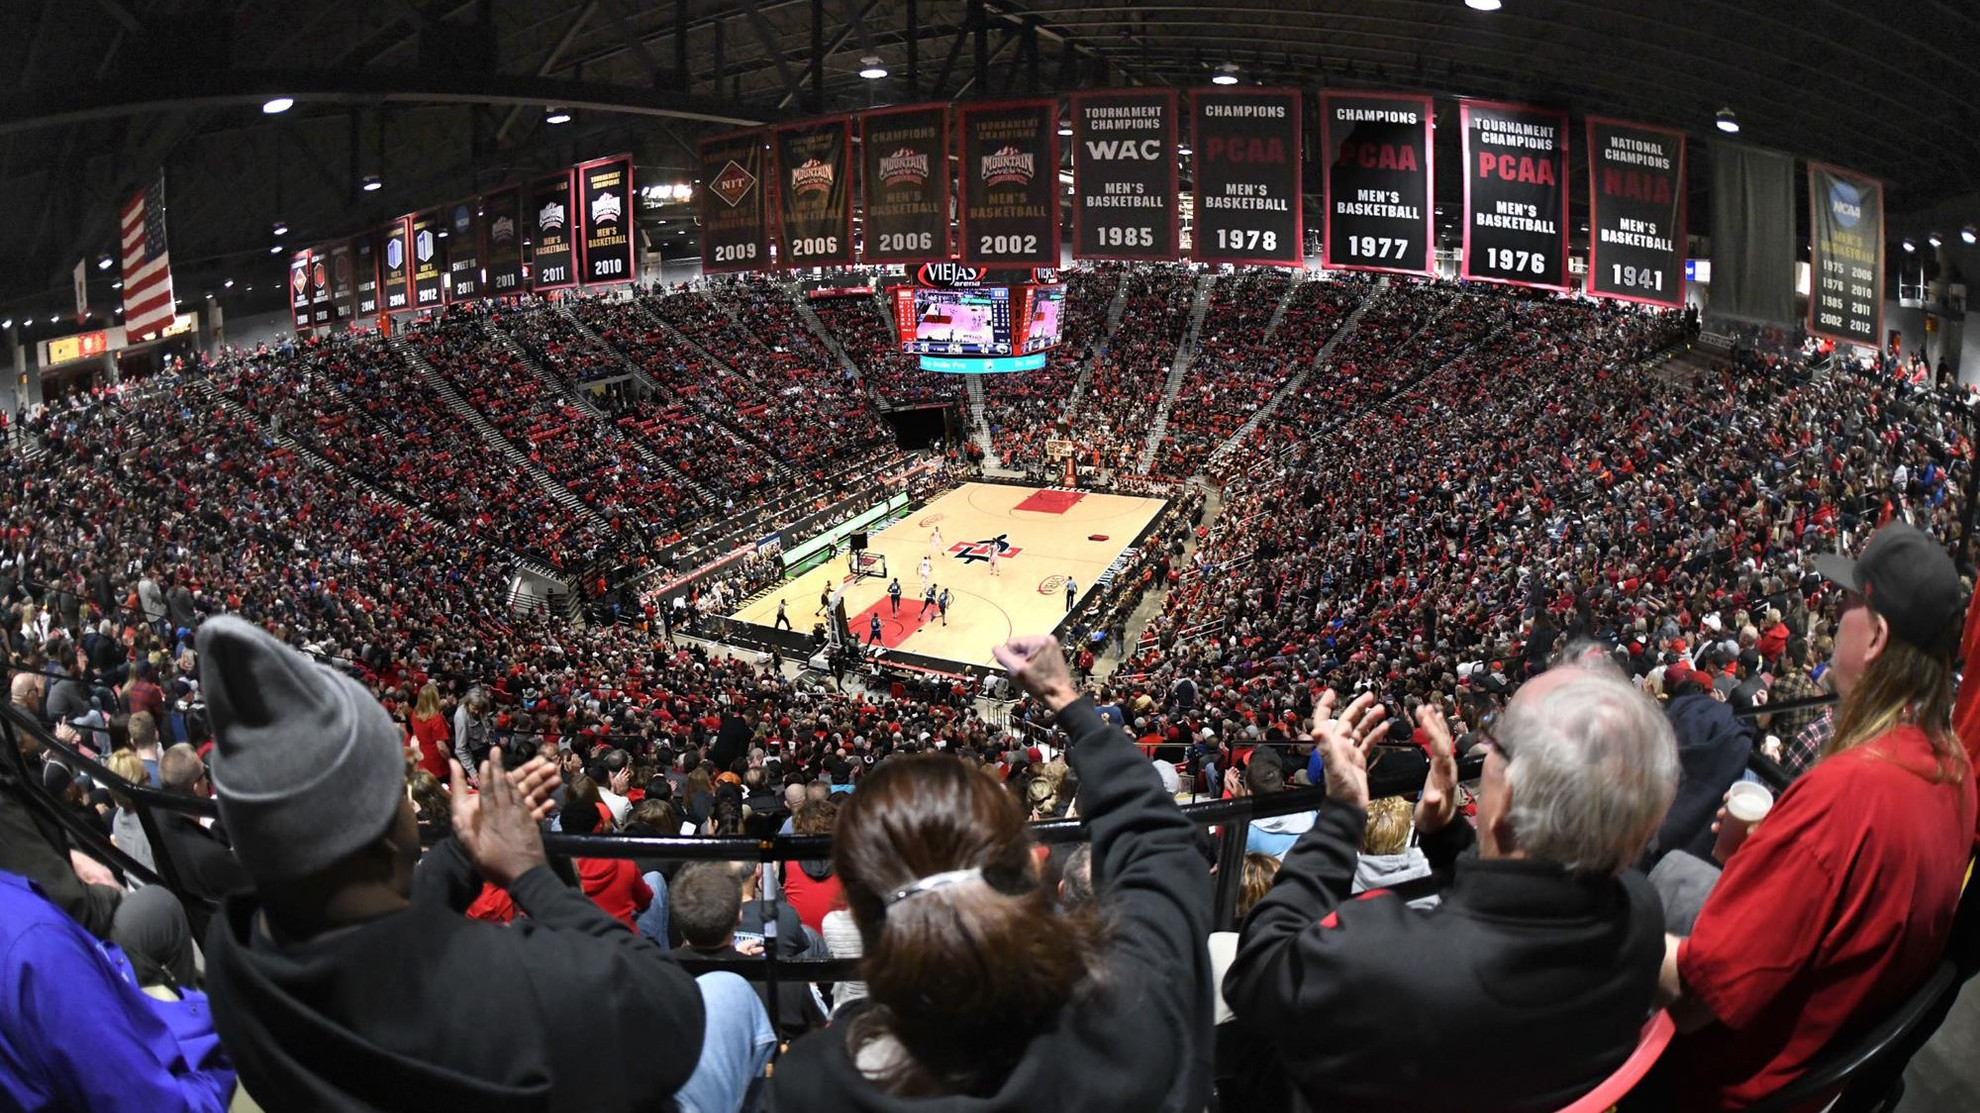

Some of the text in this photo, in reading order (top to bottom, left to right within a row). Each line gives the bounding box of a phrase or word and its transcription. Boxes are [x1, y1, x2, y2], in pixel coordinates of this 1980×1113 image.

[1085, 106, 1162, 118] TOURNAMENT
[1205, 105, 1285, 118] CHAMPIONS
[1336, 108, 1417, 124] CHAMPIONS
[1091, 118, 1161, 130] CHAMPIONS
[1474, 117, 1555, 138] TOURNAMENT
[871, 127, 936, 142] CHAMPIONS
[1481, 132, 1553, 150] CHAMPIONS
[1086, 139, 1161, 161] WAC
[1206, 135, 1286, 164] PCAA
[1611, 136, 1663, 156] NATIONAL
[879, 153, 929, 178] MOUNTAIN
[982, 153, 1034, 177] MOUNTAIN
[1339, 141, 1418, 172] PCAA
[1605, 148, 1670, 170] CHAMPIONS
[792, 164, 833, 187] MOUNTAIN
[1479, 152, 1555, 186] PCAA
[721, 178, 745, 190] NIT
[1105, 182, 1144, 194] MEN'S
[1226, 183, 1268, 196] MEN'S
[1603, 169, 1672, 204] NAIA
[1086, 195, 1163, 208] BASKETBALL
[1205, 197, 1288, 211] BASKETBALL
[1357, 189, 1400, 203] MEN'S
[870, 202, 939, 216] BASKETBALL
[970, 205, 1046, 219] BASKETBALL
[1337, 202, 1420, 220] BASKETBALL
[1496, 201, 1537, 218] MEN'S
[1833, 200, 1861, 218] NCAA
[596, 227, 617, 237] MEN'S
[1476, 212, 1556, 234] BASKETBALL
[1620, 217, 1657, 235] MEN'S
[543, 235, 561, 246] MEN'S
[588, 235, 627, 248] BASKETBALL
[792, 236, 838, 256] 2006
[879, 232, 932, 251] 2006
[980, 235, 1037, 255] 2002
[1098, 227, 1154, 247] 1985
[1217, 229, 1277, 251] 1978
[1601, 229, 1674, 252] BASKETBALL
[536, 243, 570, 256] BASKETBALL
[715, 242, 757, 262] 2009
[1349, 235, 1408, 260] 1977
[595, 258, 622, 275] 2010
[1487, 247, 1545, 274] 1976
[1822, 259, 1873, 281] 1975 2006
[496, 273, 515, 288] 2011
[543, 266, 565, 282] 2011
[926, 262, 977, 285] VIEJAS
[1612, 263, 1663, 291] 1941
[457, 281, 474, 295] 2011
[1822, 277, 1872, 299] 1976 2010
[1821, 295, 1871, 316] 1985 2011
[1820, 312, 1871, 334] 2002 2012
